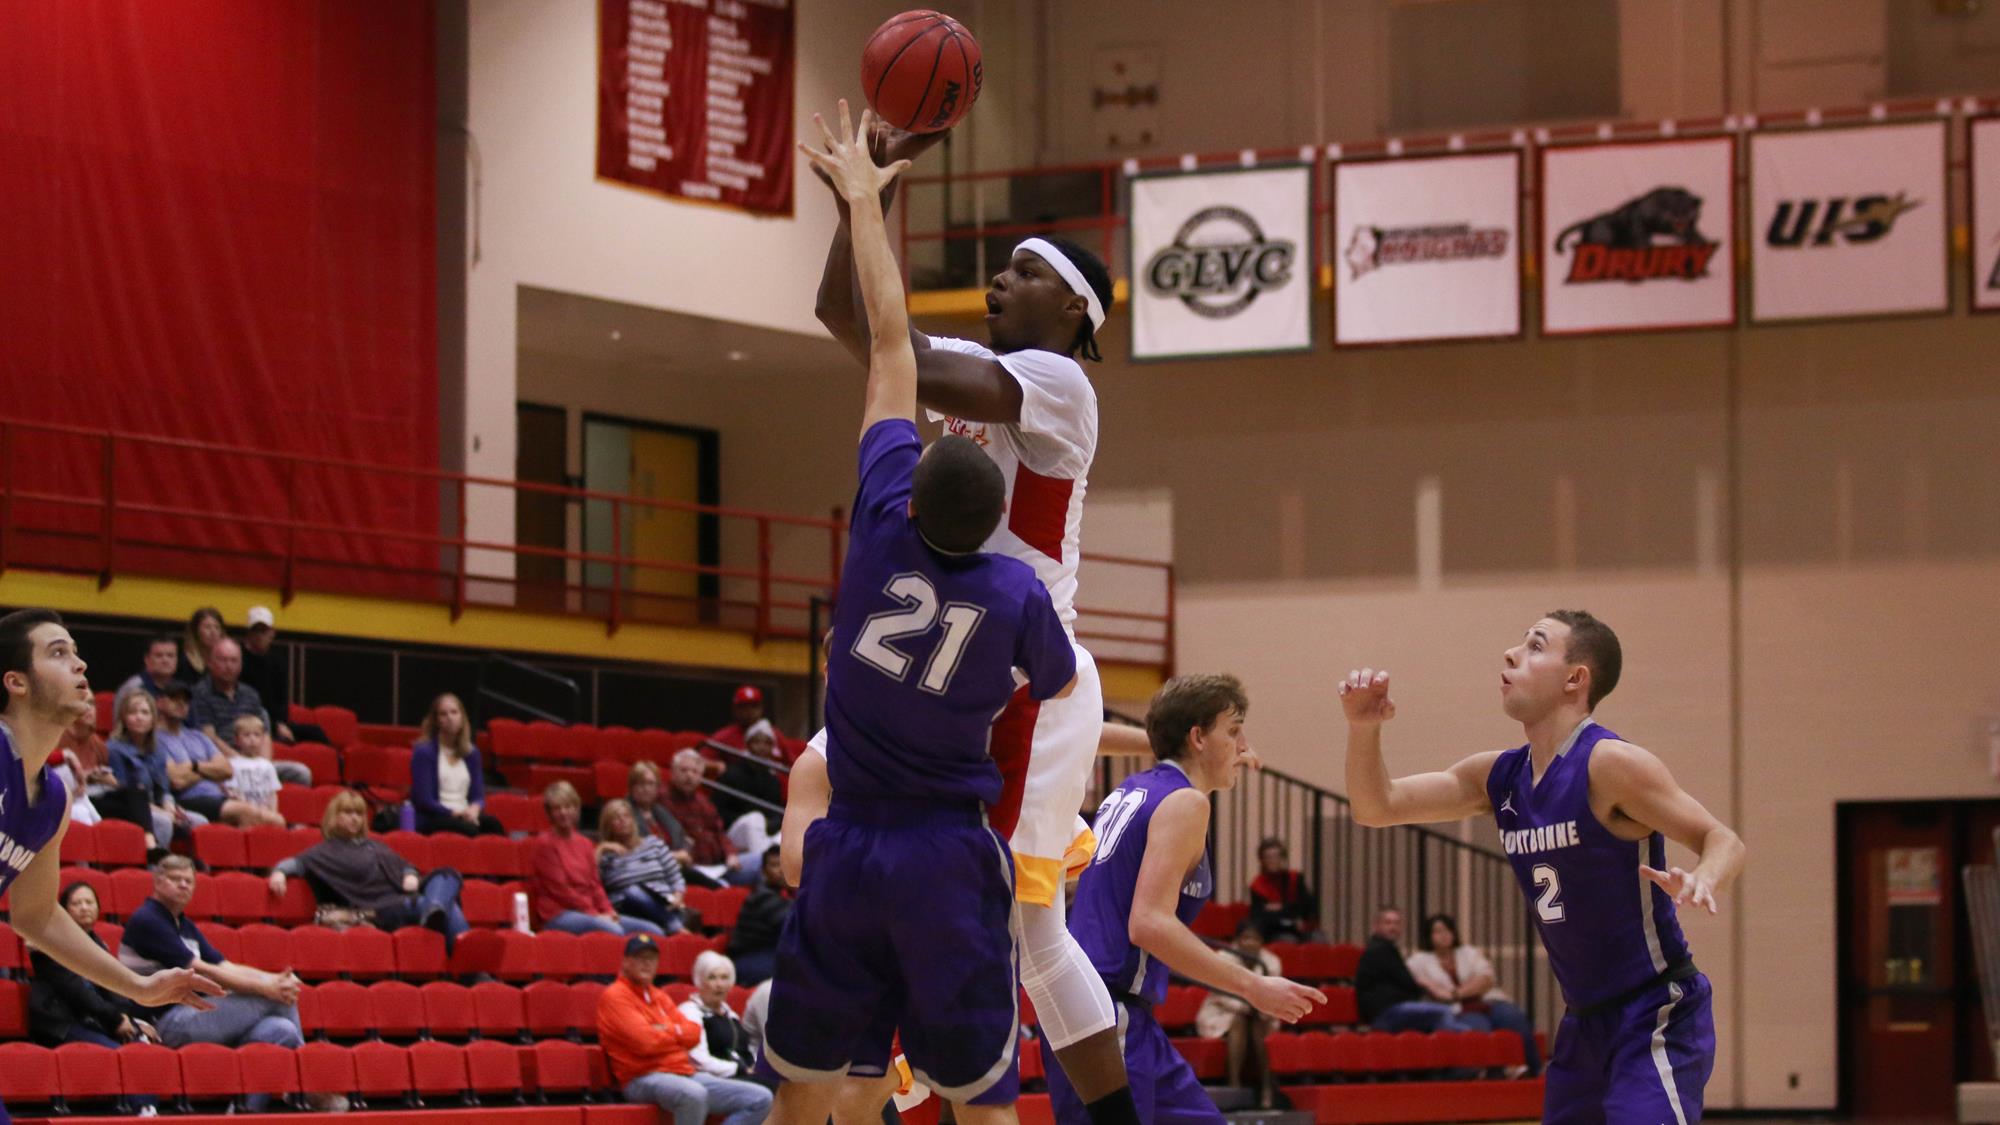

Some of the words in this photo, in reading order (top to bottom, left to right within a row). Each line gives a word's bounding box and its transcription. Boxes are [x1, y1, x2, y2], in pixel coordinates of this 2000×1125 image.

[1765, 193, 1899, 250] UIS
[1146, 242, 1293, 297] GLVC
[1565, 241, 1721, 284] DRURY
[850, 570, 987, 696] 21
[1532, 862, 1566, 924] 2
